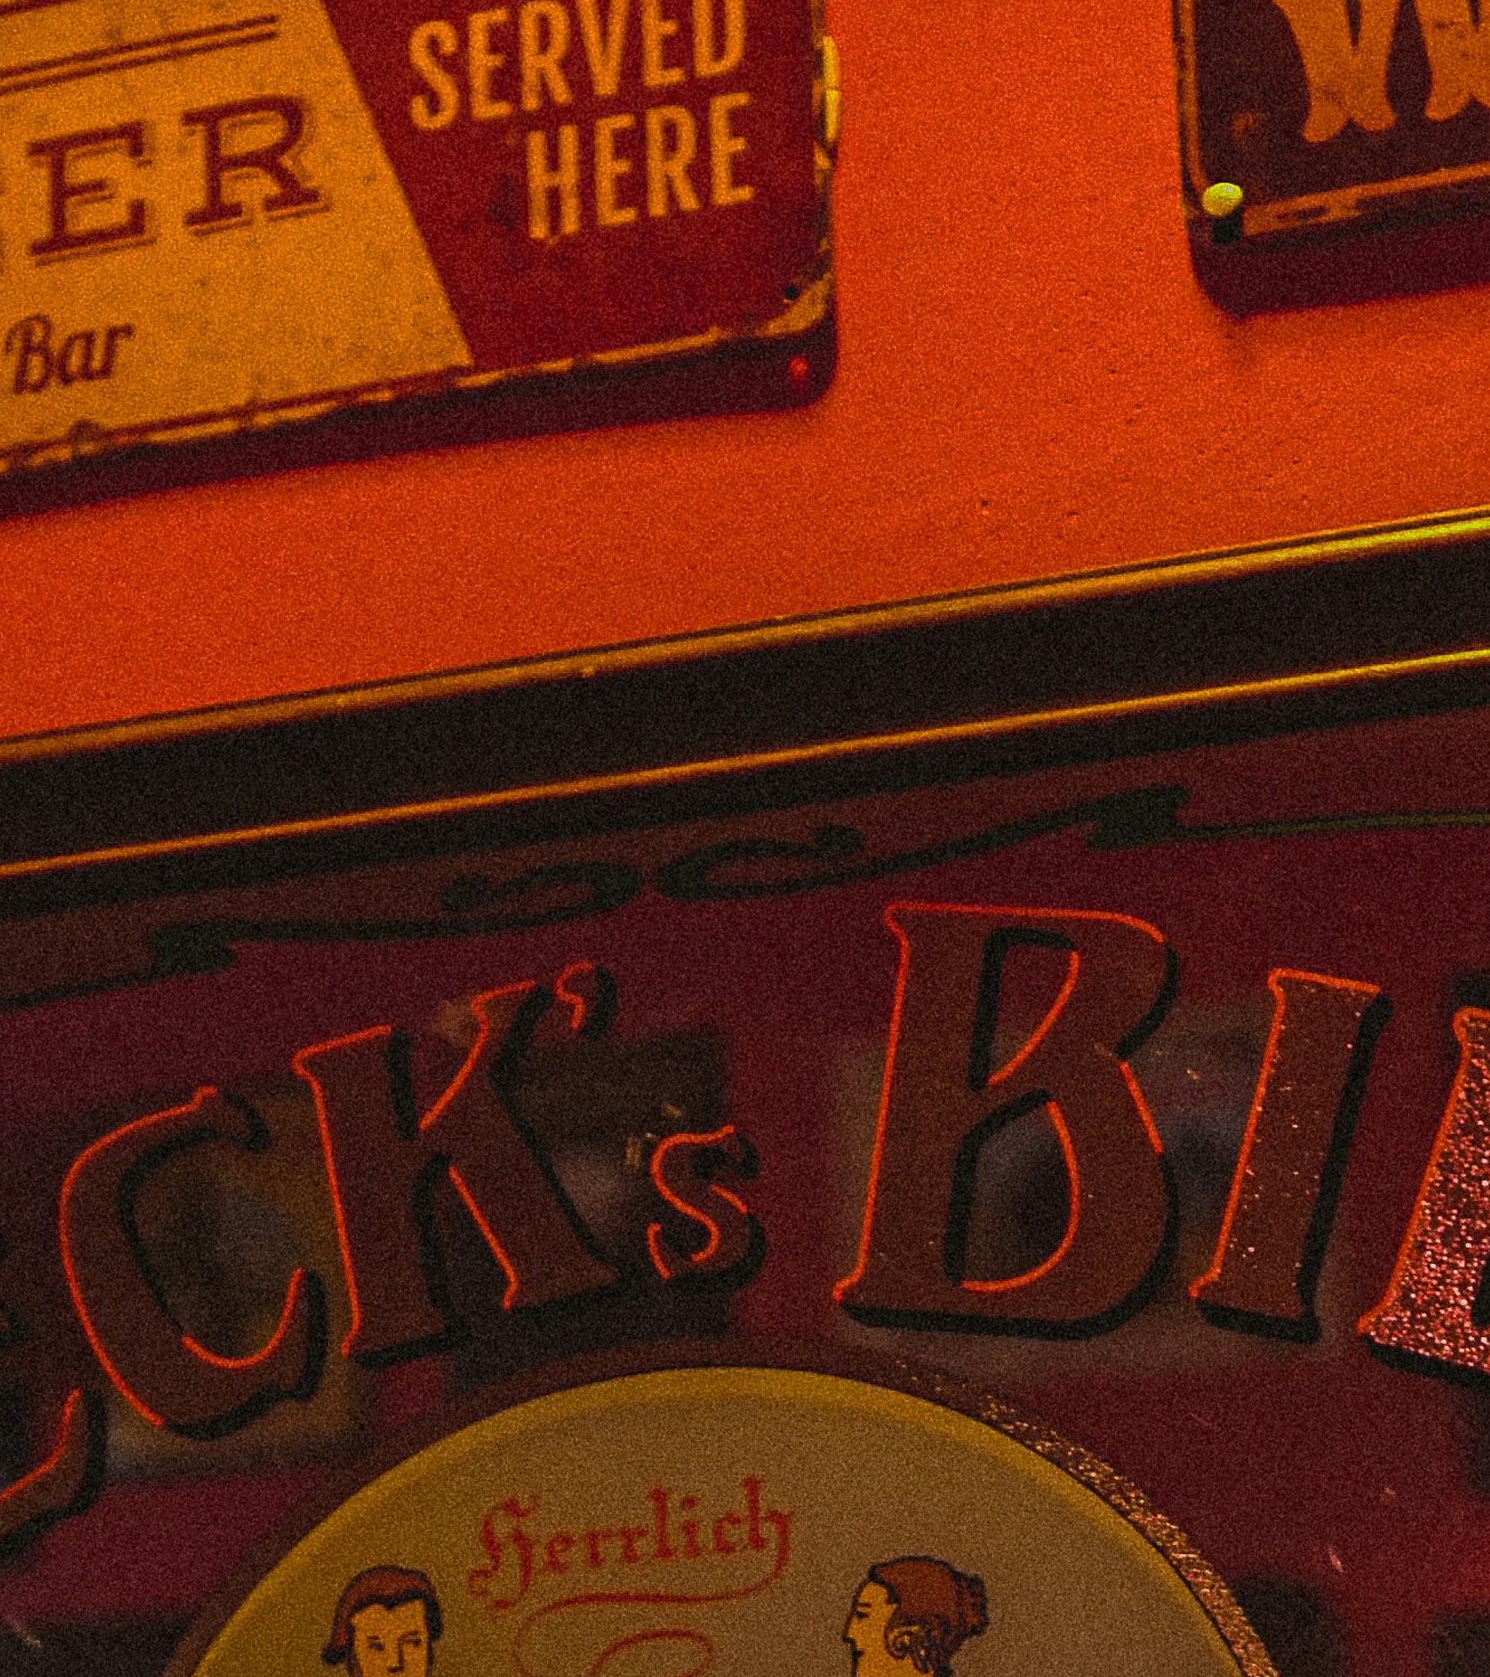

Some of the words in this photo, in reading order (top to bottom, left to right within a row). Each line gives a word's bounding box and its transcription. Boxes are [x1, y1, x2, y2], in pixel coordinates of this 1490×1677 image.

[526, 92, 755, 241] HERE
[5, 312, 136, 399] Bar
[466, 1475, 795, 1609] Herrlich
